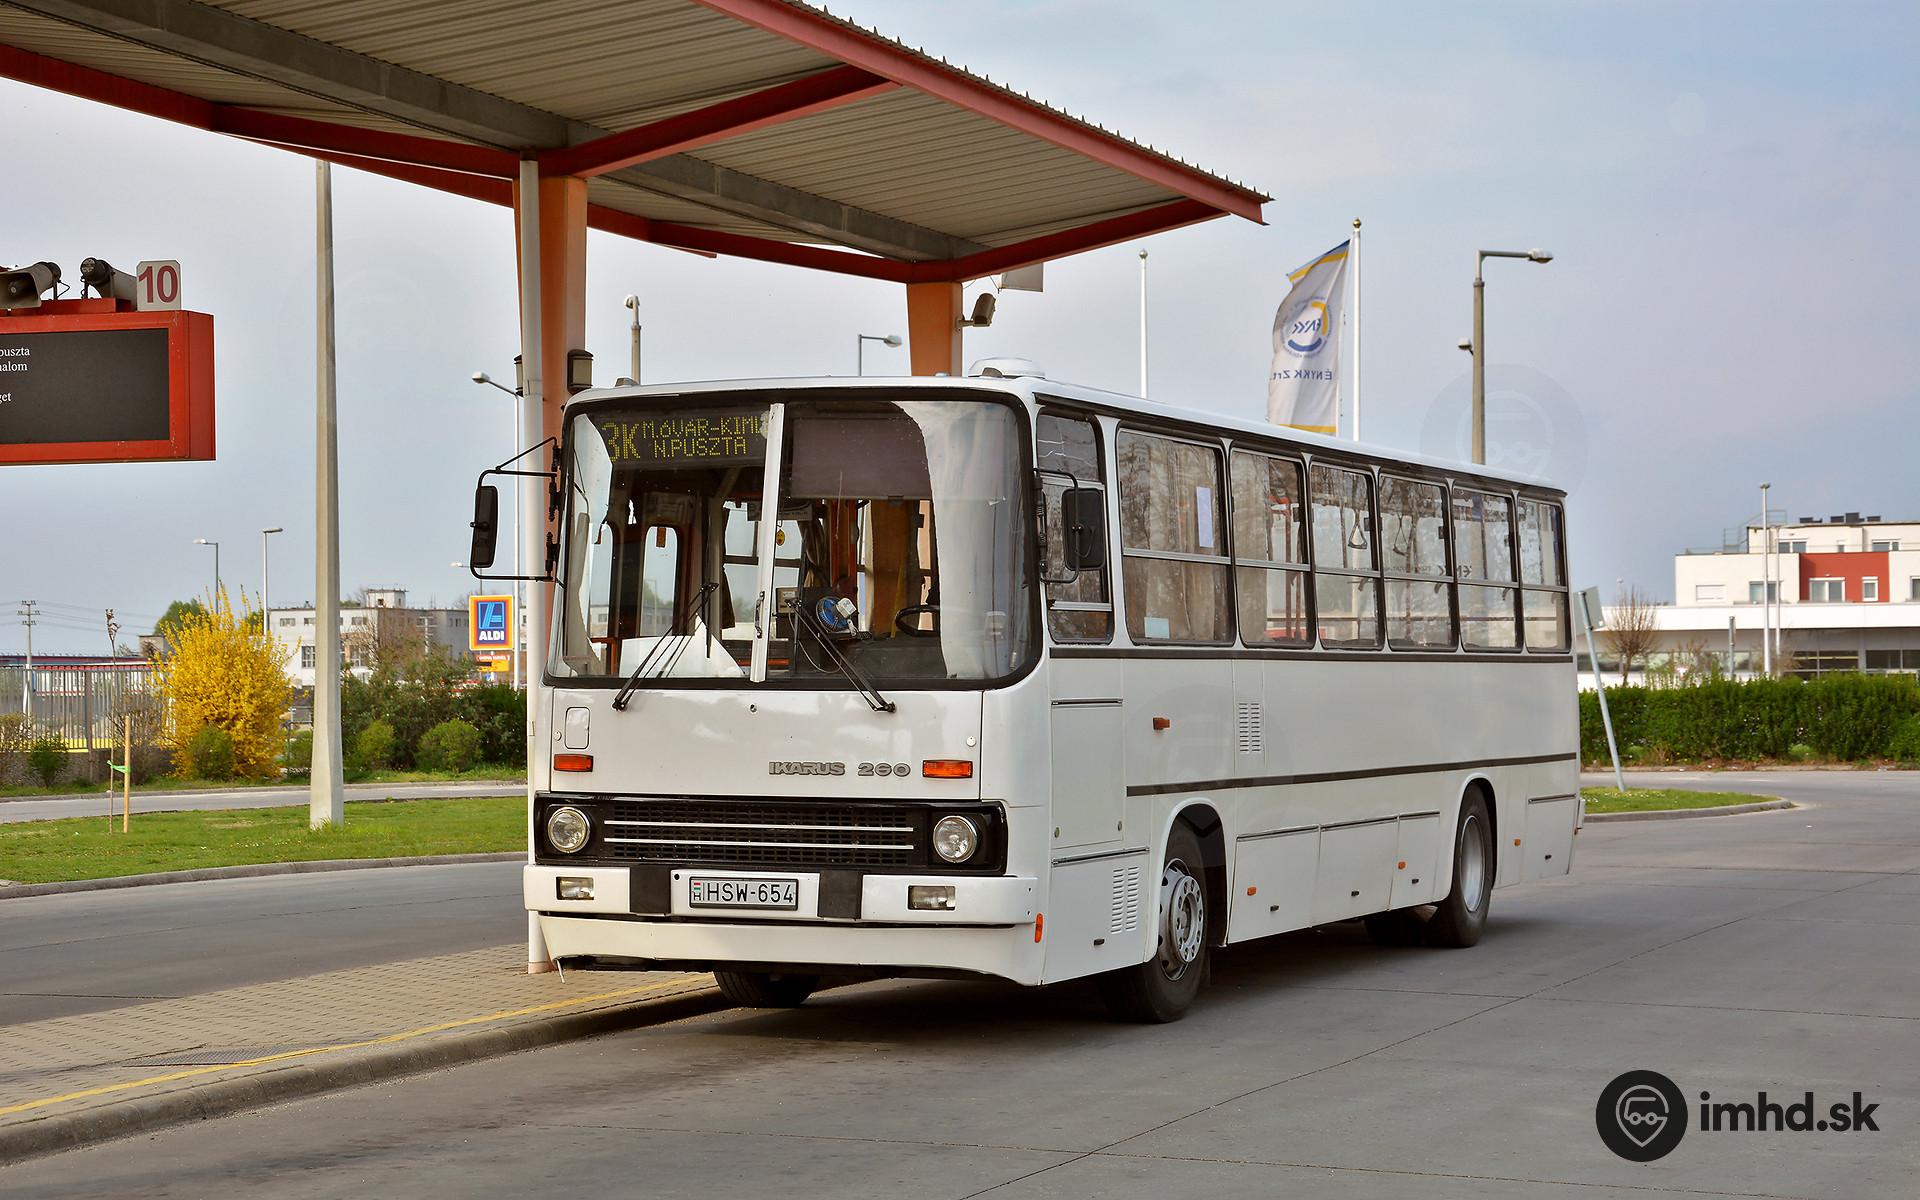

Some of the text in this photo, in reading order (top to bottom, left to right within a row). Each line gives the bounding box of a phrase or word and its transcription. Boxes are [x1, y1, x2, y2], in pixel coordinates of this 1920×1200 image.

[138, 265, 178, 304] 10
[0, 360, 28, 372] alom
[0, 392, 12, 405] et
[601, 422, 641, 462] 3K
[654, 436, 747, 458] N.PUSZTA
[478, 630, 505, 641] ALDI
[768, 761, 911, 778] IKARUS 260
[707, 882, 793, 903] HSW-654
